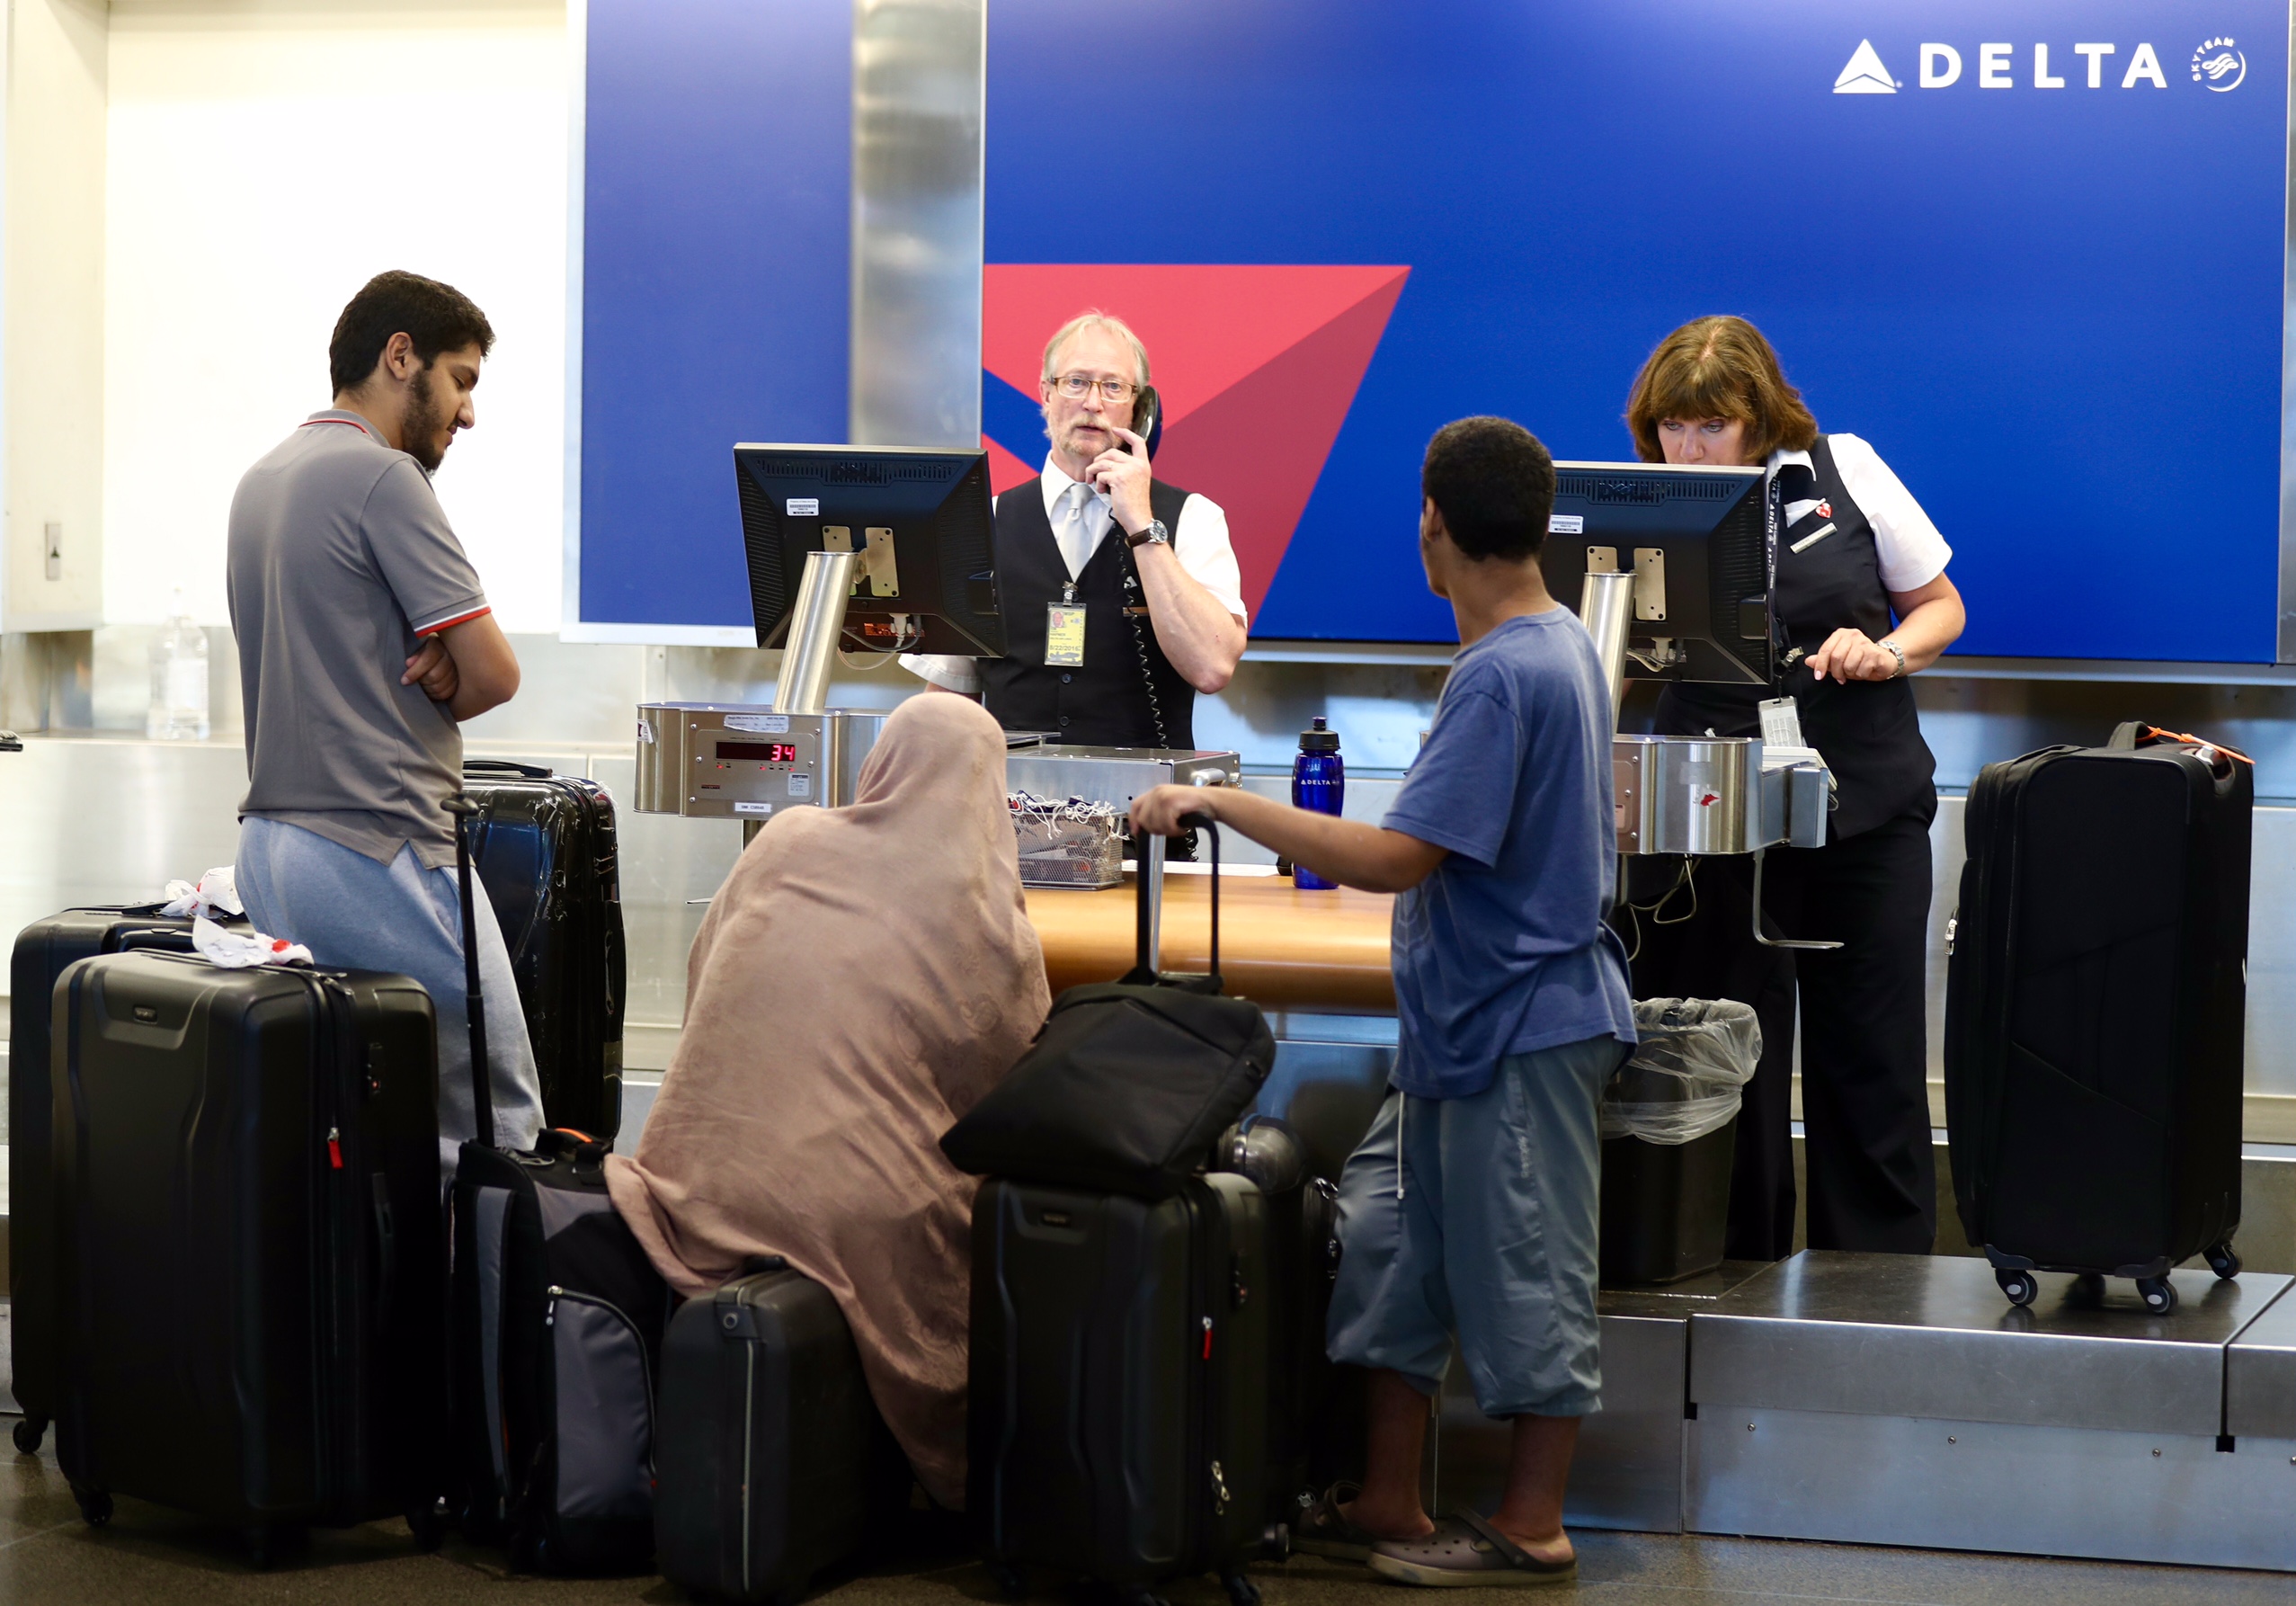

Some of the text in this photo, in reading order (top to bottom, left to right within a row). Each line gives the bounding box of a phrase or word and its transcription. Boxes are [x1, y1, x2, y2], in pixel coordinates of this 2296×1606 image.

[1919, 43, 2167, 88] DELTA
[2191, 37, 2235, 81] SKYTEAM
[771, 744, 796, 762] 34
